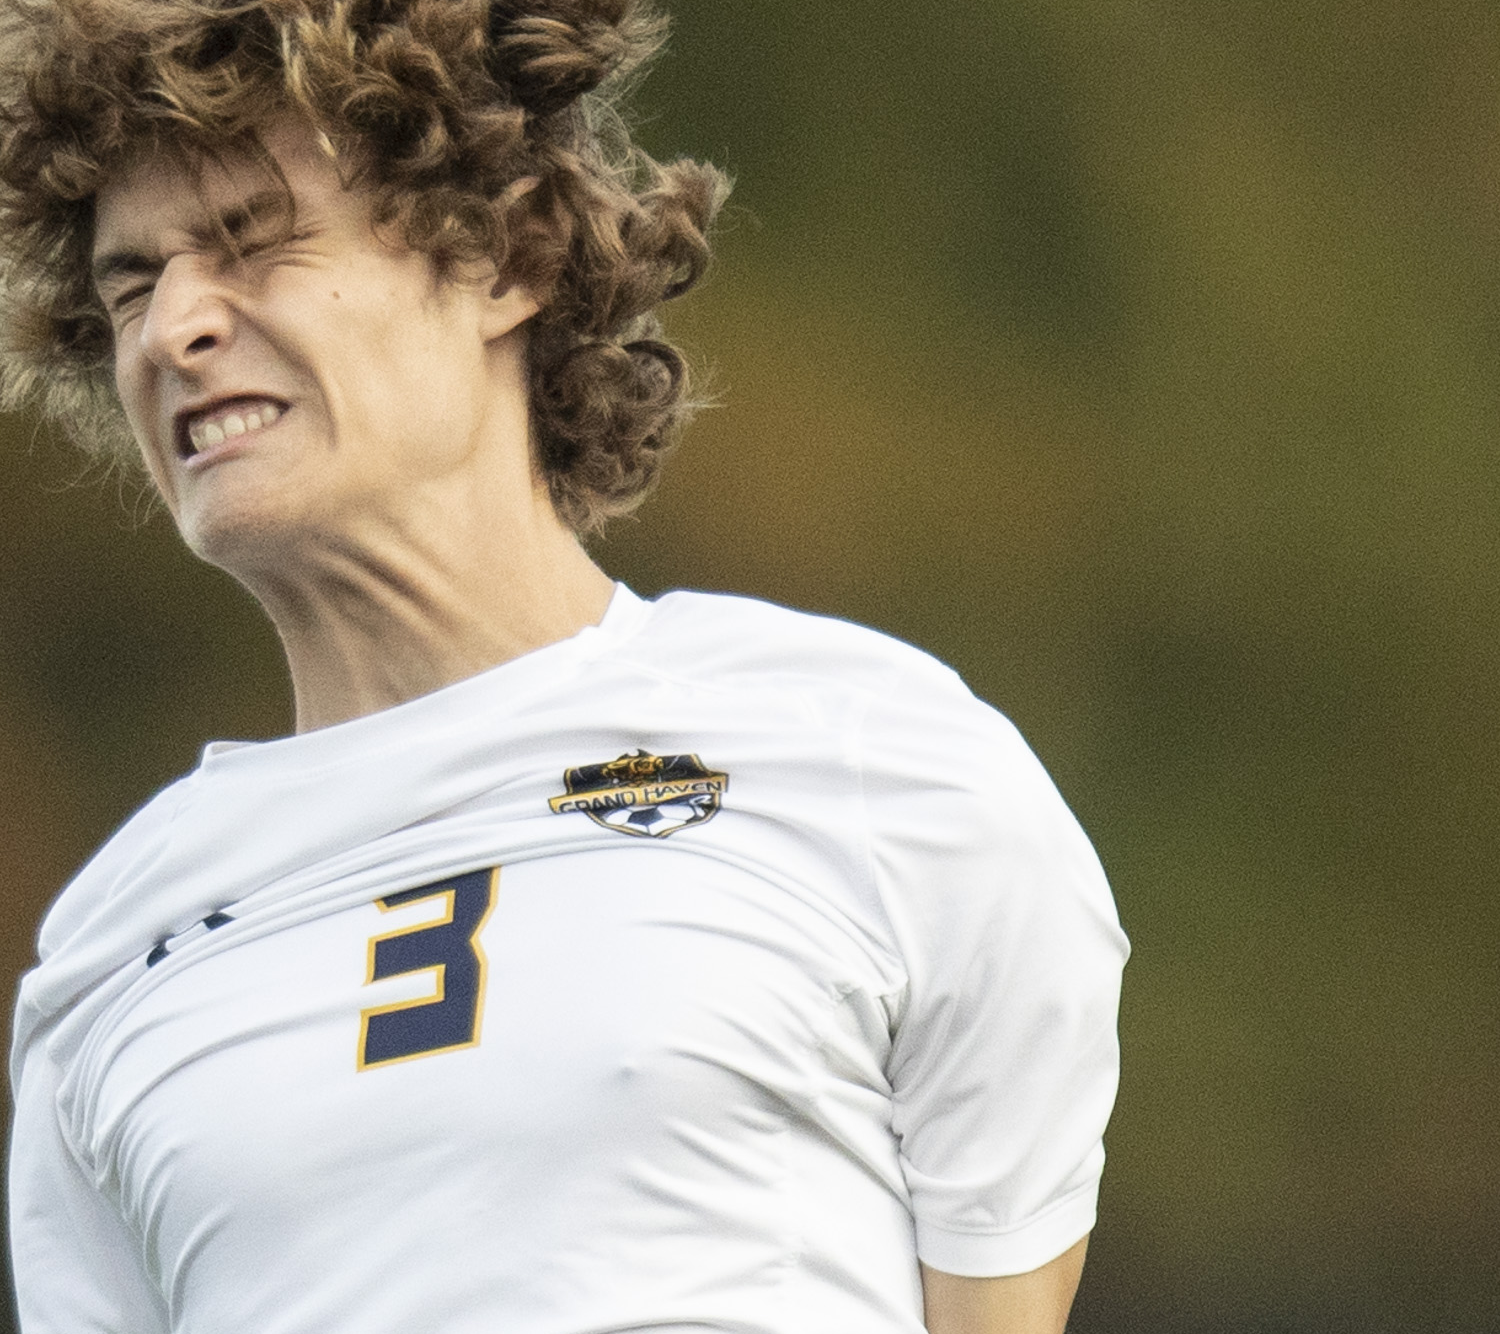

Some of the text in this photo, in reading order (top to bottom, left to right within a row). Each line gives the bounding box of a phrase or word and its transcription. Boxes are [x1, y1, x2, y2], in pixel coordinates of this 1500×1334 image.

[559, 790, 636, 813] GRAND
[644, 780, 722, 803] HAVEN
[357, 865, 502, 1072] 3
